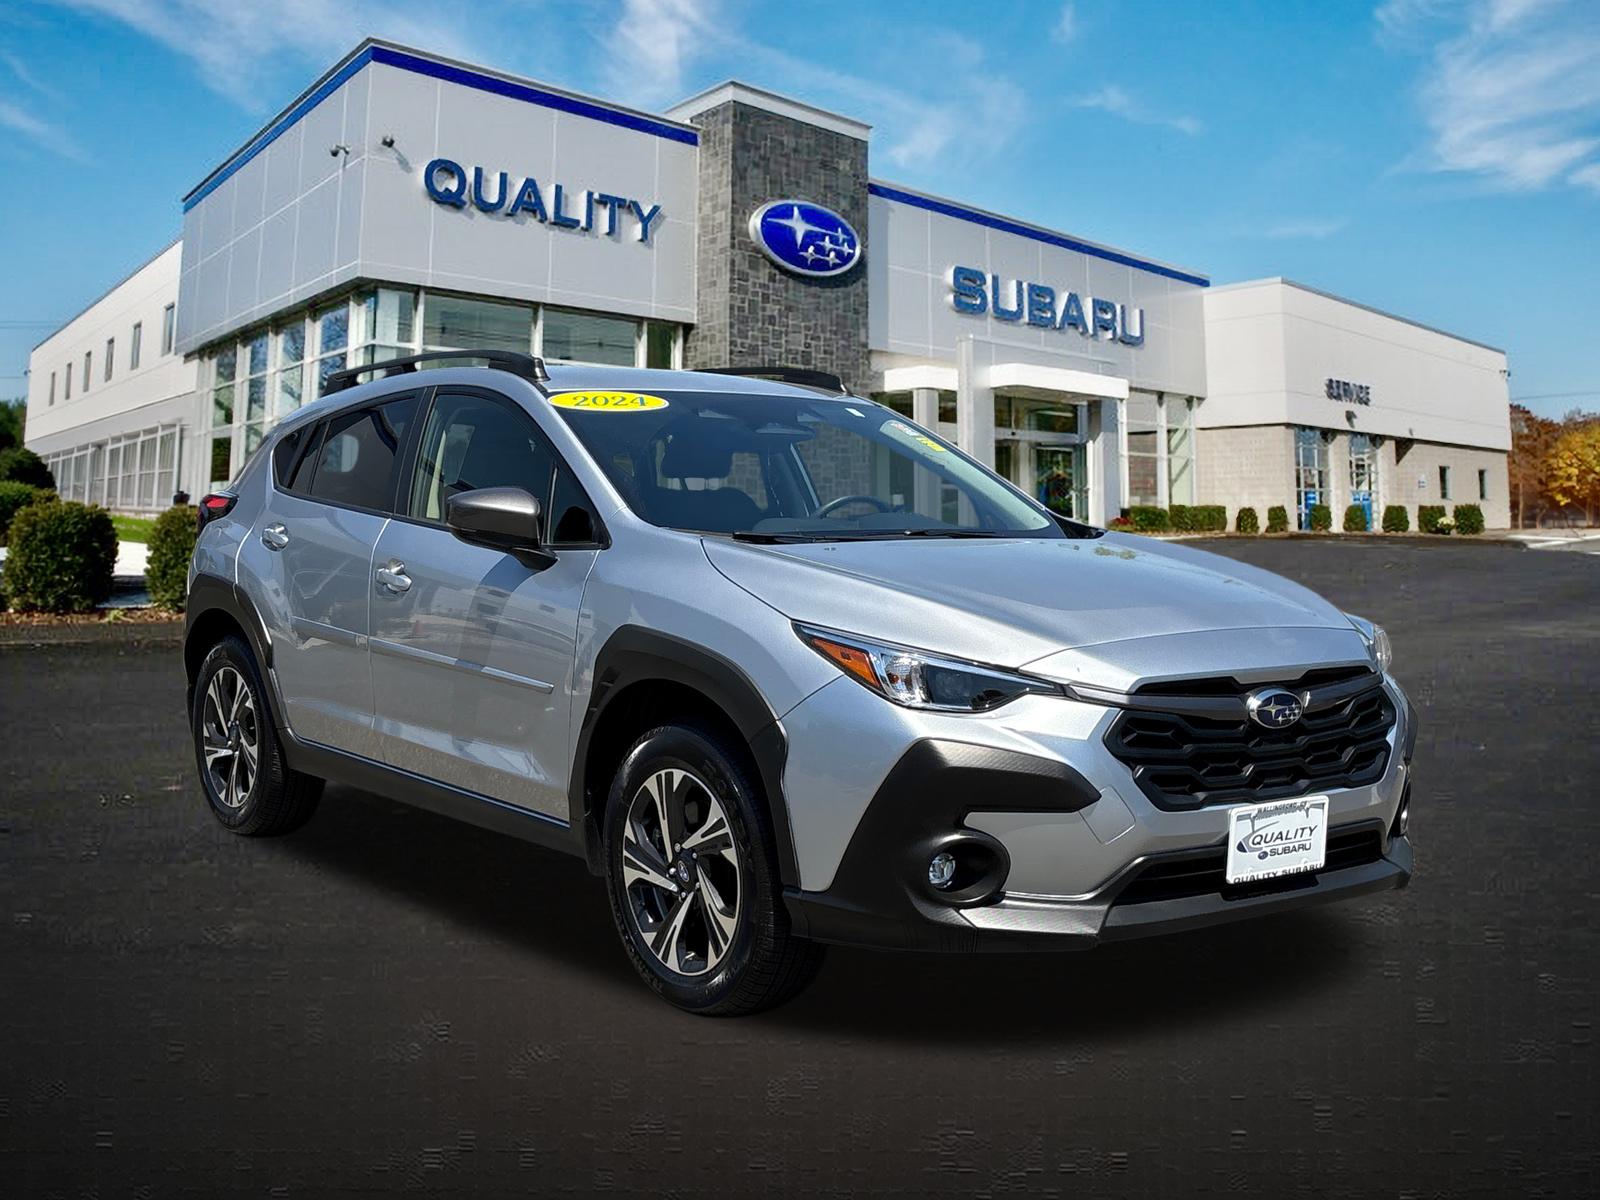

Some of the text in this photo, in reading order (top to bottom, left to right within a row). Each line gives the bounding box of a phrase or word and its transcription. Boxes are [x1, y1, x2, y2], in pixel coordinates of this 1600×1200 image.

[424, 158, 662, 243] QUALITY
[950, 265, 1145, 347] SUBARU
[572, 395, 648, 407] 2024
[1252, 825, 1318, 845] QUALITY
[1269, 843, 1312, 857] SUBARU
[1234, 863, 1323, 884] QUALITY SUBARU
